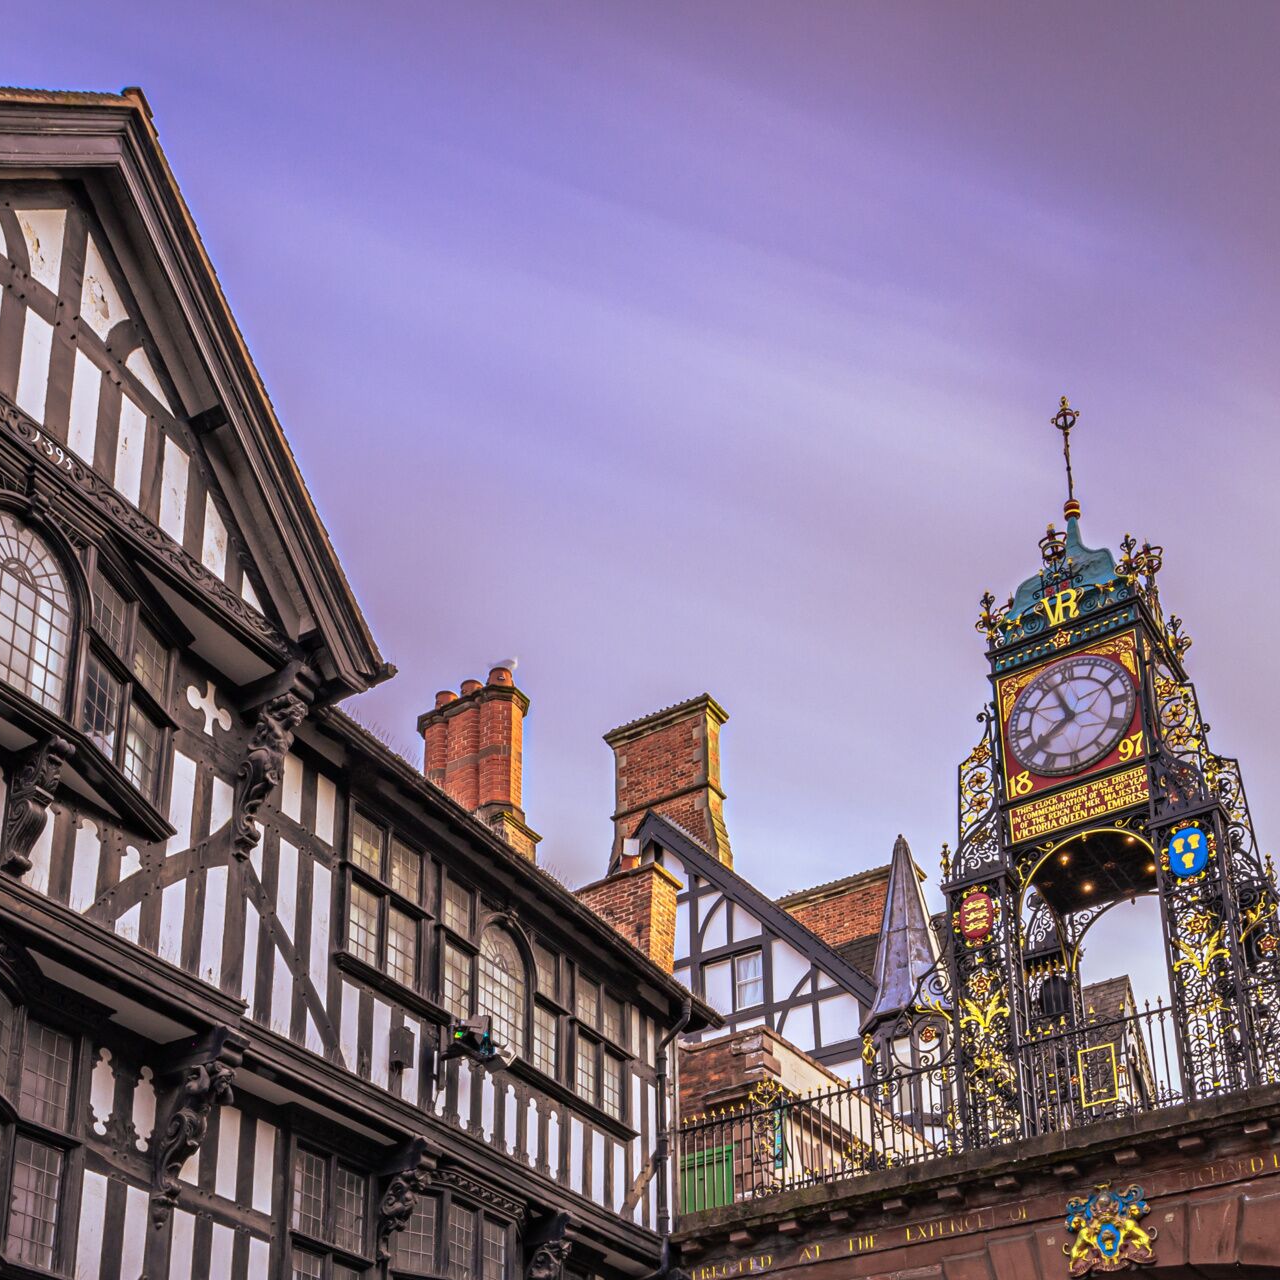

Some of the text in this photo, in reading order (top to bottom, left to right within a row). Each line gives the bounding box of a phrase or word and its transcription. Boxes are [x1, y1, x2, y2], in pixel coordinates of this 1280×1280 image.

[1041, 588, 1080, 627] VR
[1118, 731, 1144, 762] 97
[1009, 770, 1034, 798] 18
[1013, 816, 1022, 825] IN
[1023, 793, 1088, 821] COMMEMORATION
[1089, 789, 1098, 799] OF
[1100, 785, 1114, 796] THE
[1128, 774, 1148, 786] YEAR
[1016, 769, 1144, 816] THIS CLOCK TOWER WAS ERECTED
[1020, 783, 1142, 829] OF THE REIGN OF HER MAJESTY
[1015, 819, 1058, 840] VICTORIA
[1090, 805, 1106, 816] AND
[1107, 788, 1150, 810] EMPRESS
